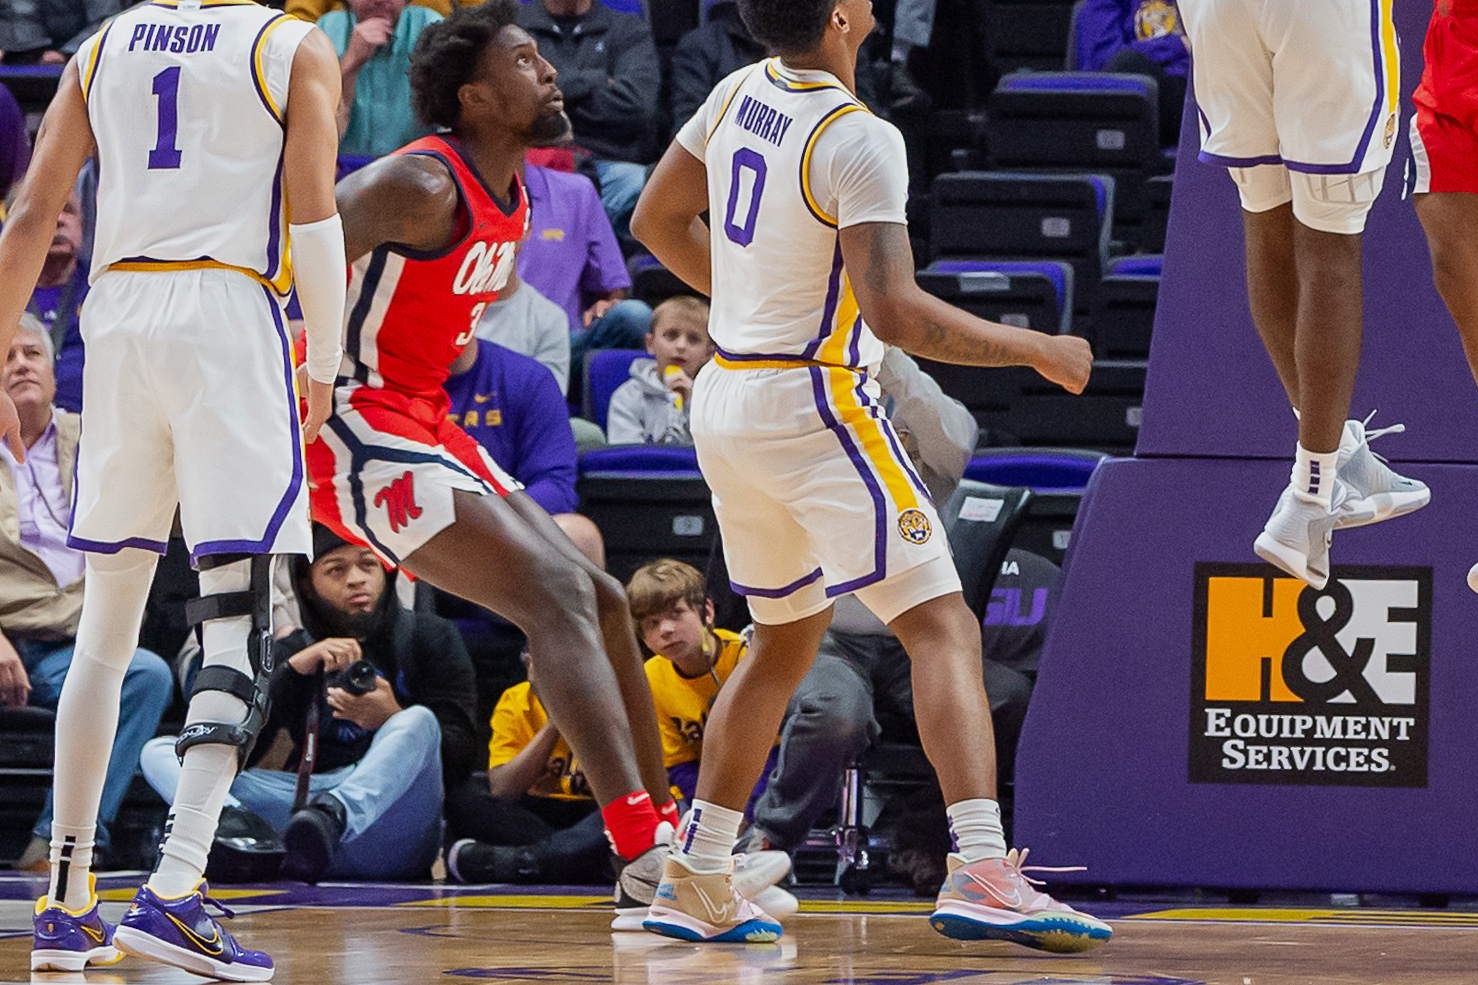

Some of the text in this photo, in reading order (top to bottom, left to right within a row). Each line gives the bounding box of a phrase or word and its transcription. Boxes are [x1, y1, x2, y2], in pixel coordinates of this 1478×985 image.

[128, 24, 221, 53] PINSON
[147, 66, 182, 170] 1
[735, 95, 793, 147] MURRAY
[724, 147, 767, 248] 0
[1204, 577, 1418, 705] H&E
[1204, 708, 1415, 741] EQUIPMENT
